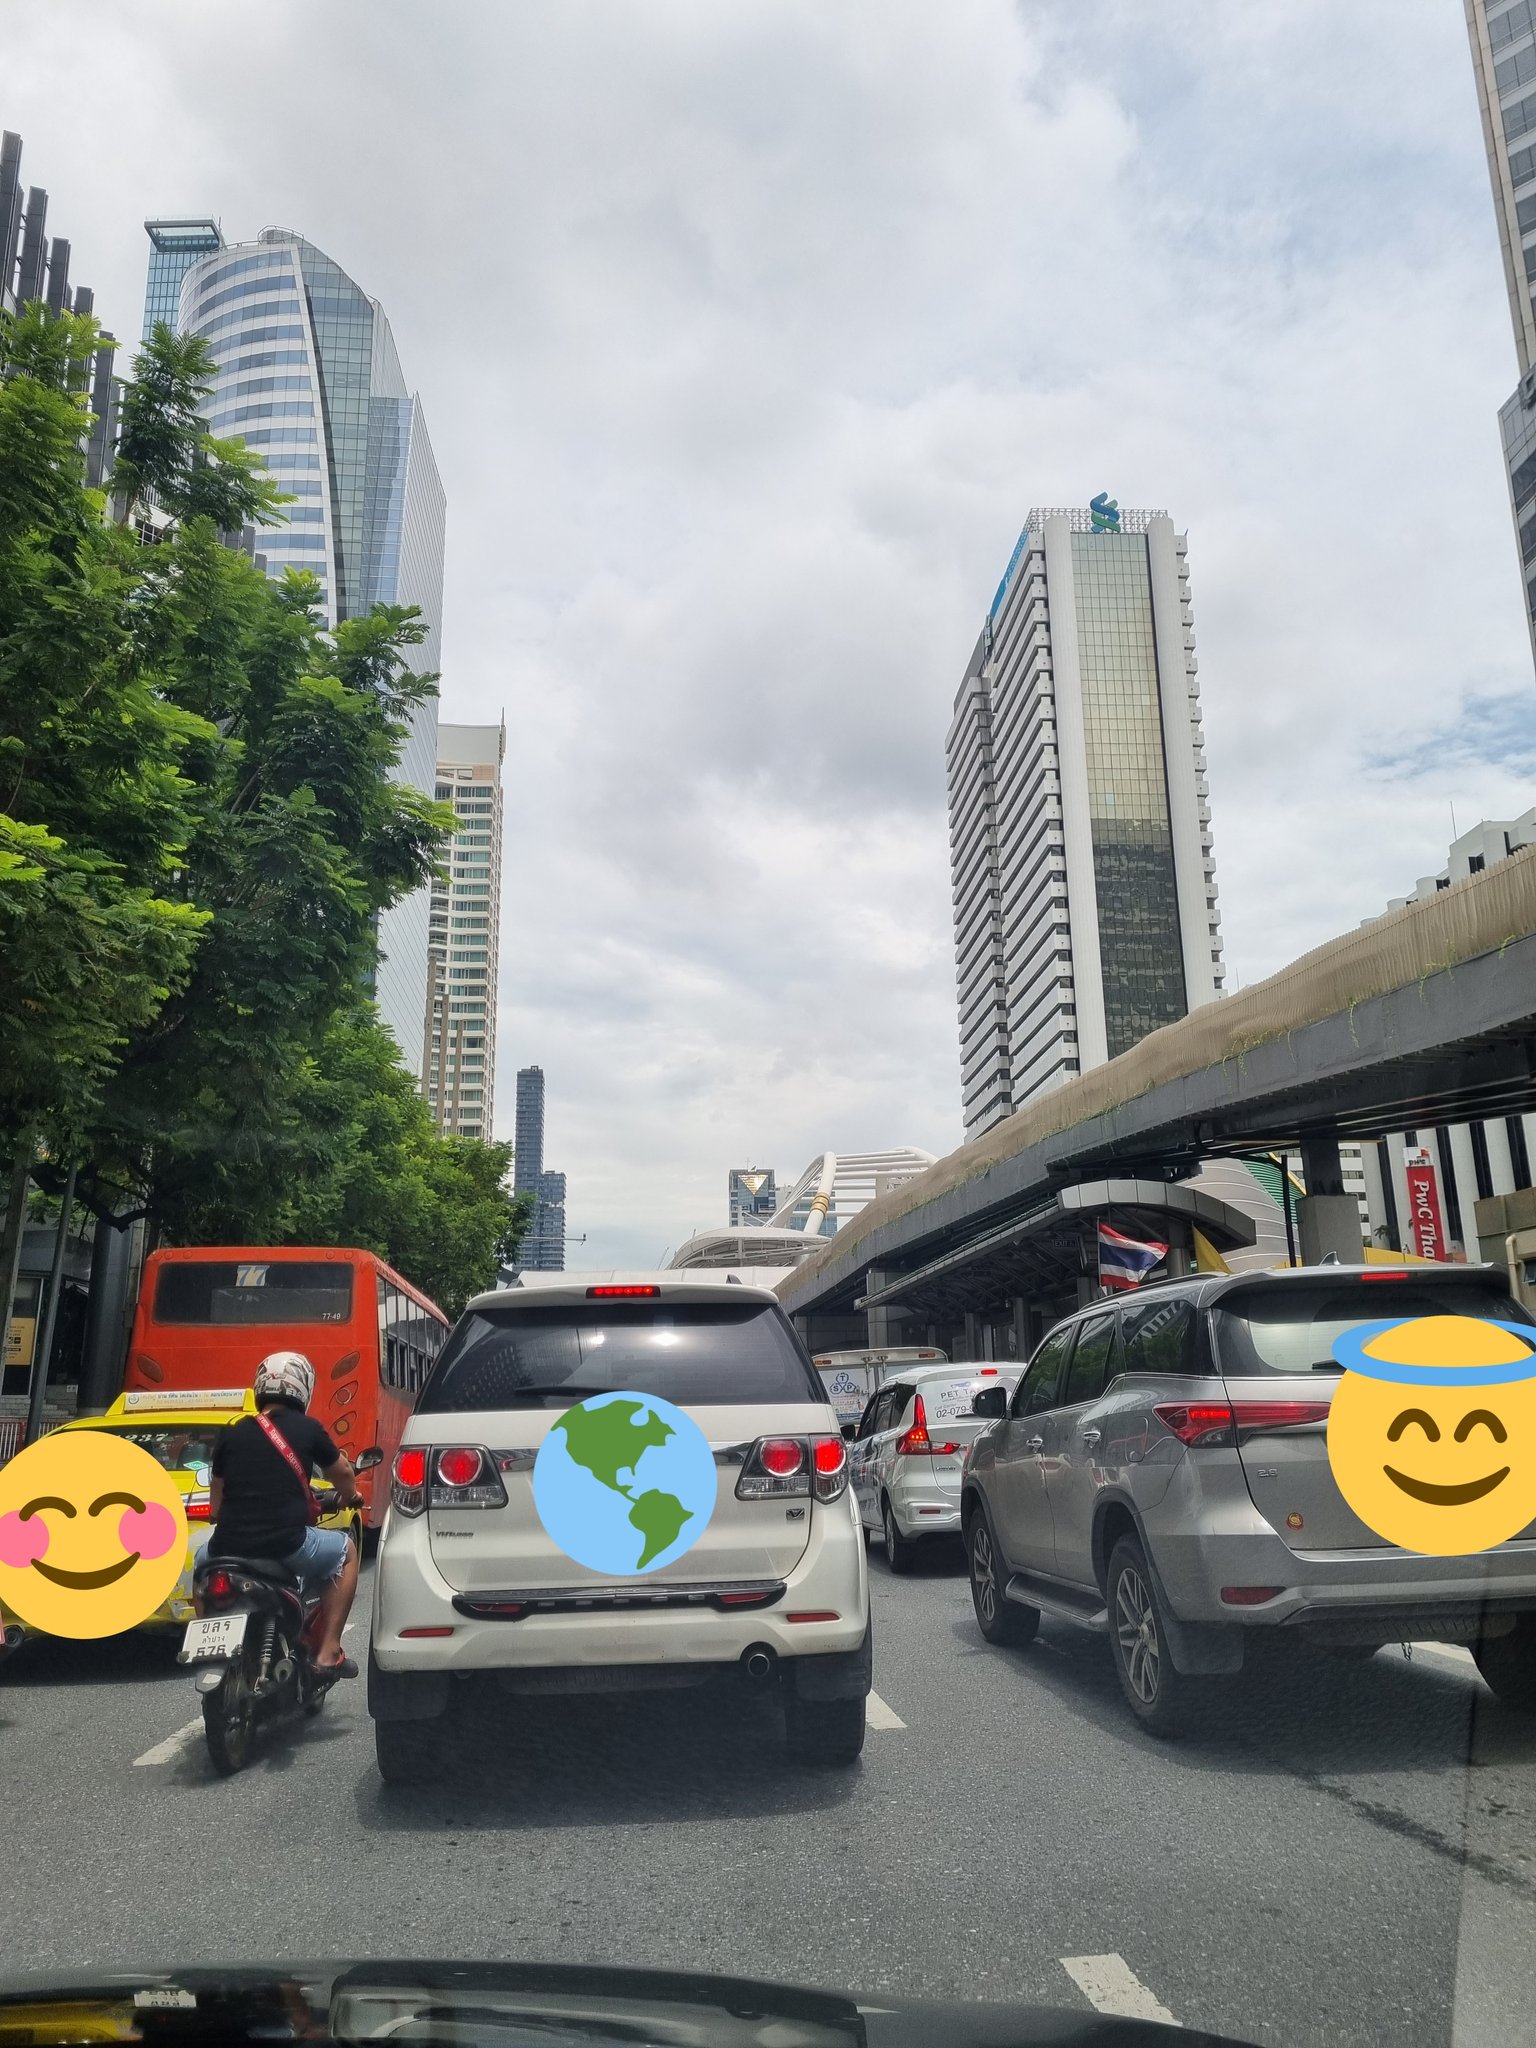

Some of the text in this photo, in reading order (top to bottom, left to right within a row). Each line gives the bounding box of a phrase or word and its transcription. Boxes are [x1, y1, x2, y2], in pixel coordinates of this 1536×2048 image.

[1413, 1179, 1438, 1259] PwC Tha
[237, 1265, 270, 1287] 77
[322, 1312, 341, 1320] 77-49
[940, 1390, 959, 1399] PET
[936, 1405, 973, 1418] 02-079-9
[202, 1620, 231, 1634] ขลร
